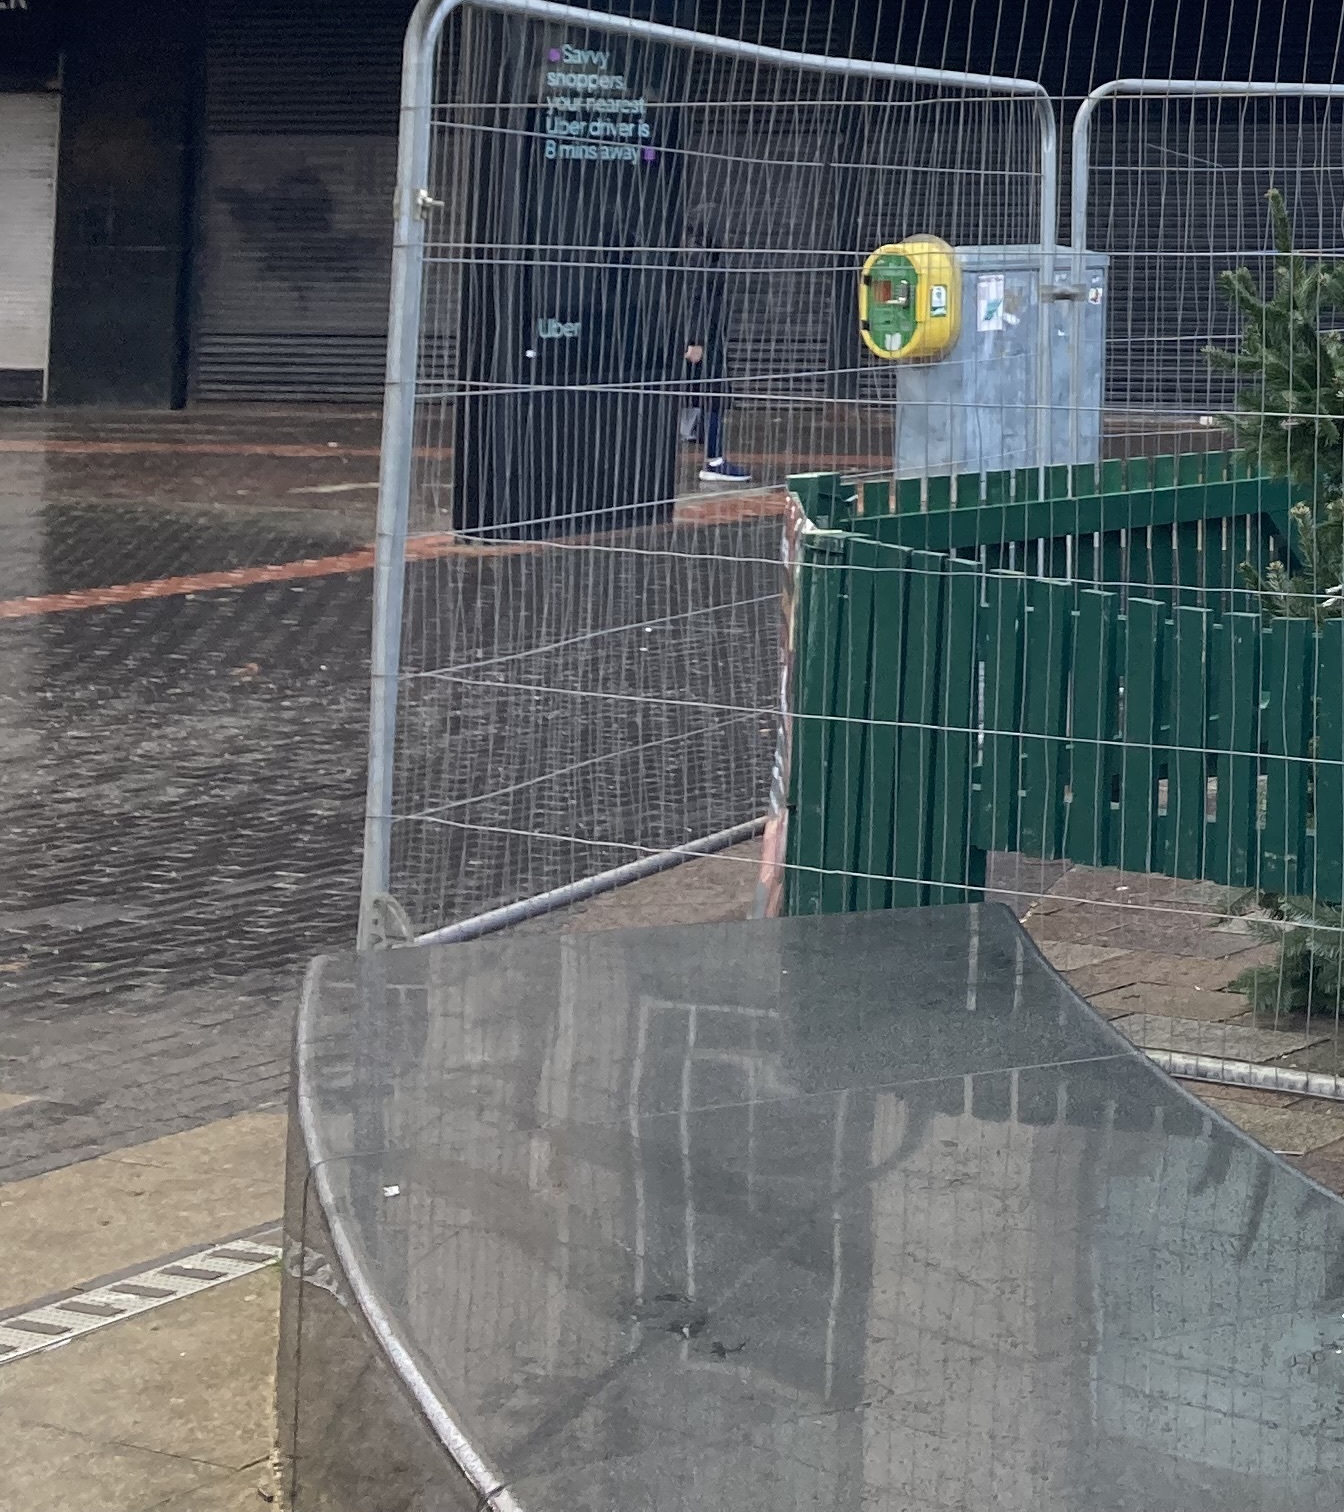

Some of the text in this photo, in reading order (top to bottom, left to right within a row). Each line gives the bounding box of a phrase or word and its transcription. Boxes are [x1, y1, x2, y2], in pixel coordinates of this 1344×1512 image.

[562, 44, 610, 69] Savvy
[547, 97, 645, 115] your nearest
[546, 116, 650, 137] Uber driver is
[545, 140, 640, 165] 8 mins away
[537, 318, 581, 338] Uber
